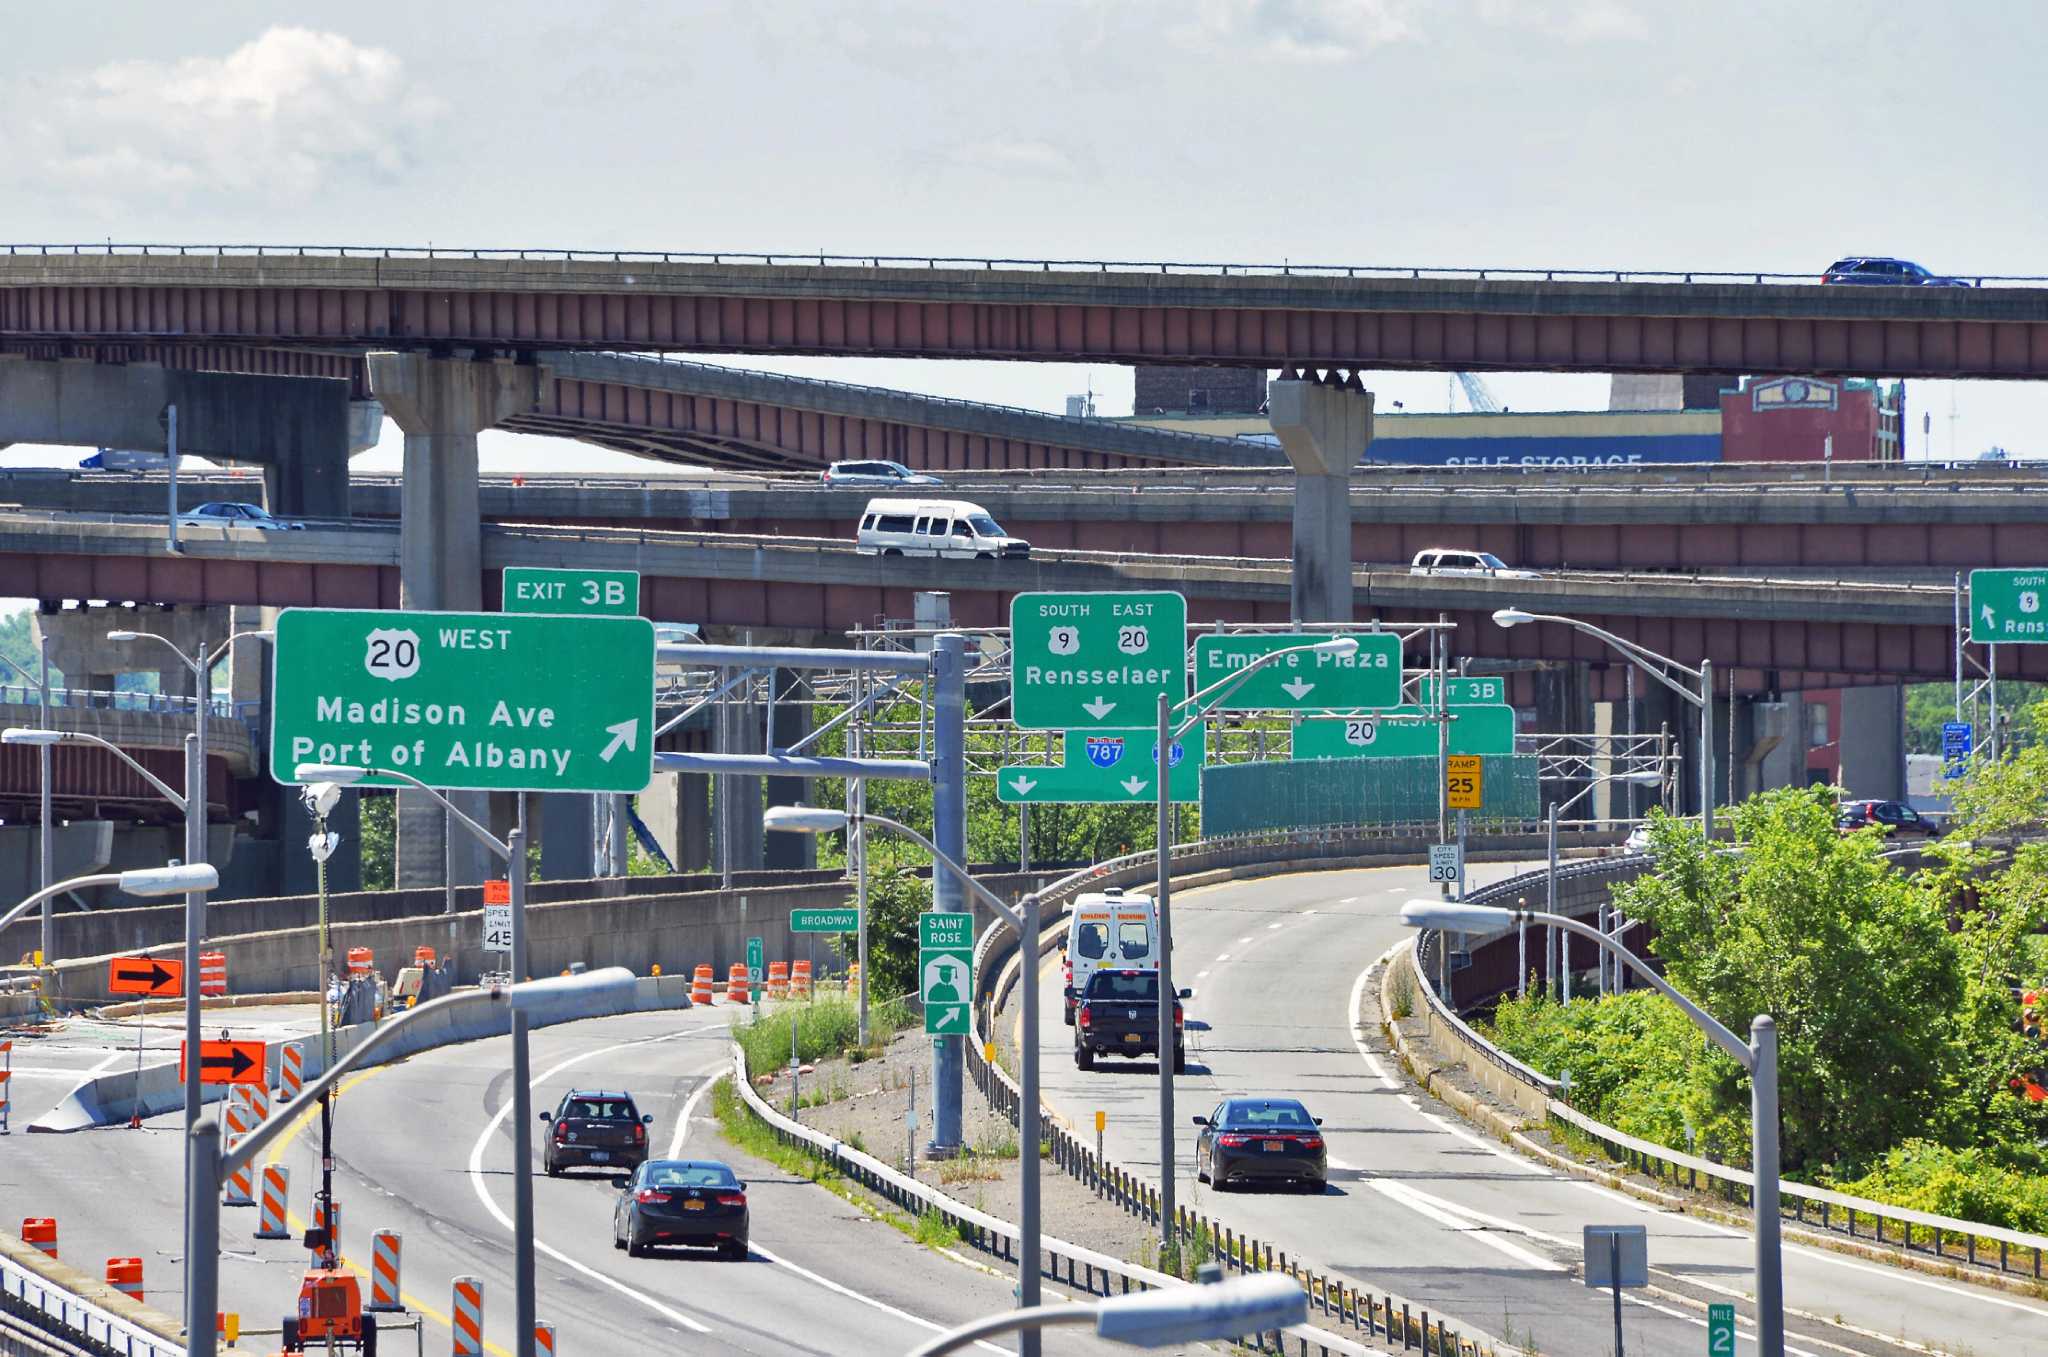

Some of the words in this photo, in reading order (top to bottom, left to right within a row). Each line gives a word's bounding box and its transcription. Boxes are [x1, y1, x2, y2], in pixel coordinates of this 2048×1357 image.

[2013, 576, 2046, 586] SOUTH
[517, 582, 566, 599] EXIT
[581, 580, 625, 605] 3B
[2026, 596, 2033, 608] 9
[1039, 605, 1090, 616] SOUTH
[1112, 604, 1154, 616] EAST
[1058, 632, 1069, 649] 9
[1121, 631, 1146, 648] 20
[370, 639, 415, 668] 20
[439, 628, 512, 650] WEST
[1316, 651, 1389, 669] Plaza
[1026, 666, 1171, 685] Rensselaer
[1469, 683, 1495, 698] 3B
[316, 696, 466, 726] Madison
[489, 700, 556, 728] Ave
[1348, 722, 1374, 740] 20
[292, 736, 373, 765] Port
[391, 739, 425, 766] of
[445, 740, 571, 776] Albany
[1089, 745, 1121, 760] 787
[1447, 760, 1476, 769] RAMP
[1448, 778, 1474, 793] 25
[1433, 866, 1457, 880] 30
[487, 909, 512, 917] SPEE
[801, 916, 853, 925] BROADWAY
[929, 918, 963, 929] SAINT
[487, 931, 512, 946] 45
[930, 933, 961, 943] ROSE
[1712, 1309, 1731, 1321] MILE
[1713, 1328, 1730, 1351] 2
